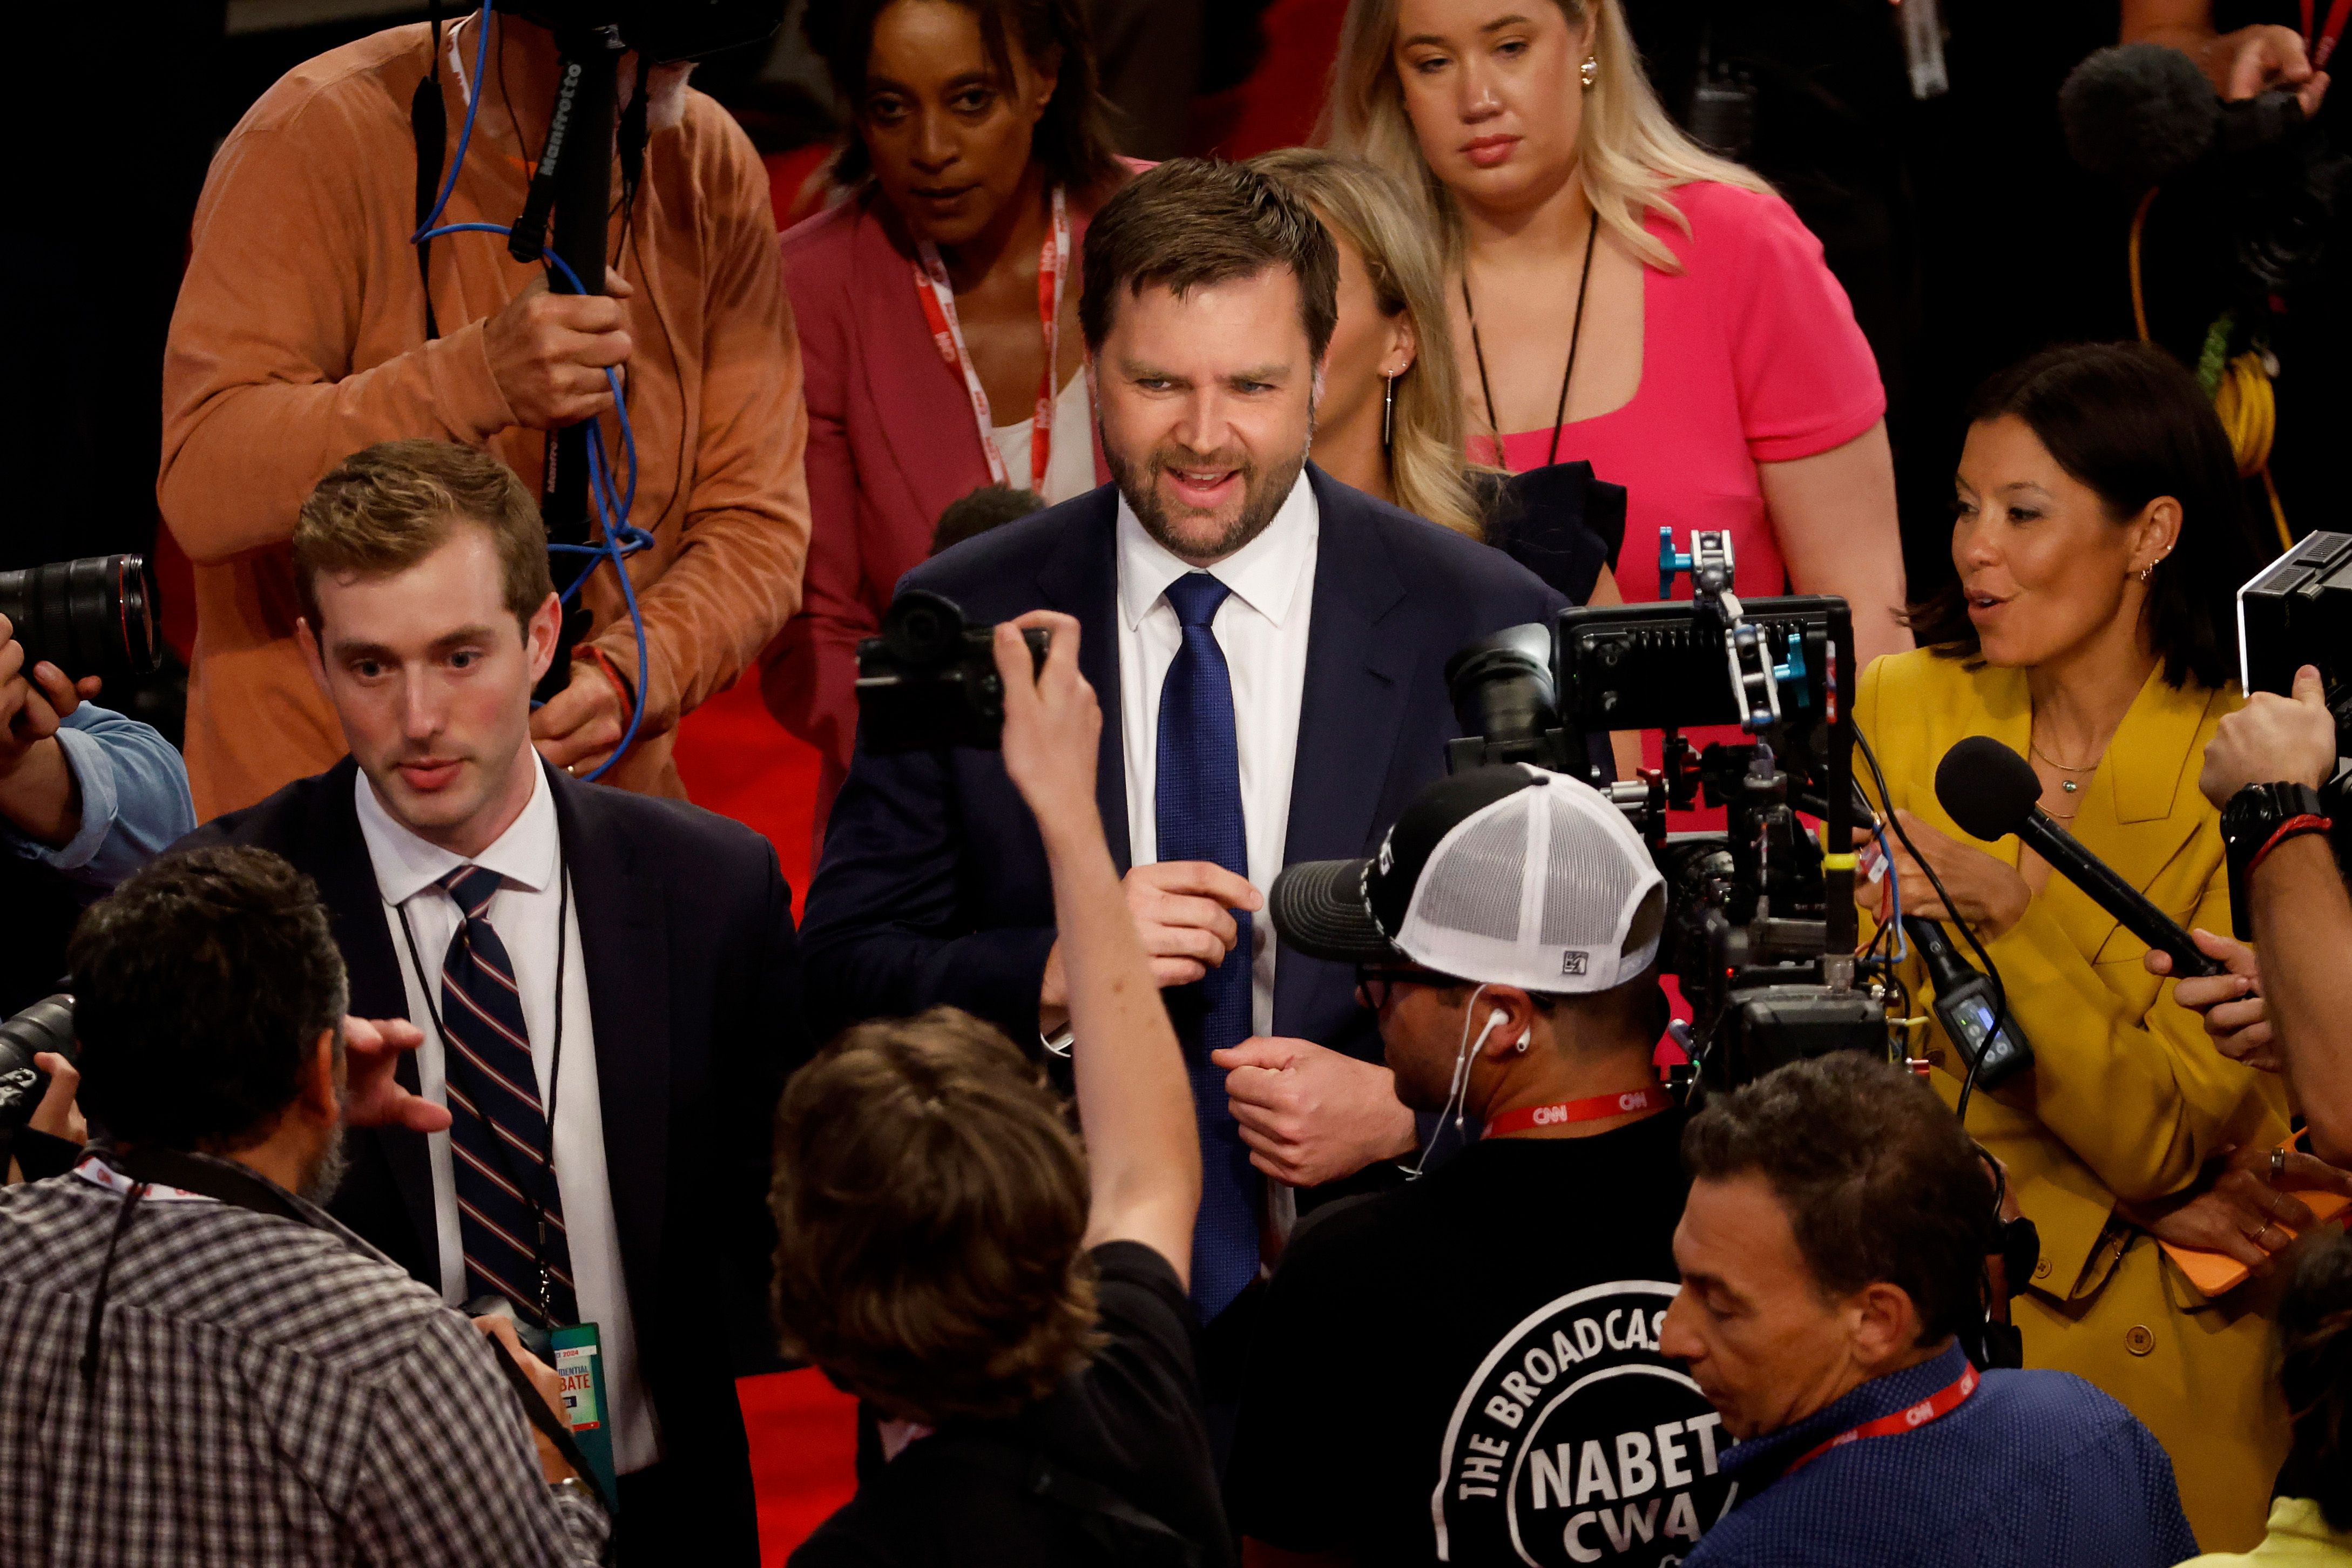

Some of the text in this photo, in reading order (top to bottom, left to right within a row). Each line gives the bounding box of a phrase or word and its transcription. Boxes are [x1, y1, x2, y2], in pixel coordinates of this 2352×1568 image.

[1532, 1104, 1567, 1125] CNN
[1459, 1433, 1510, 1501] THE
[1530, 1411, 1722, 1510] NABET
[1563, 1491, 1702, 1563] CWA
